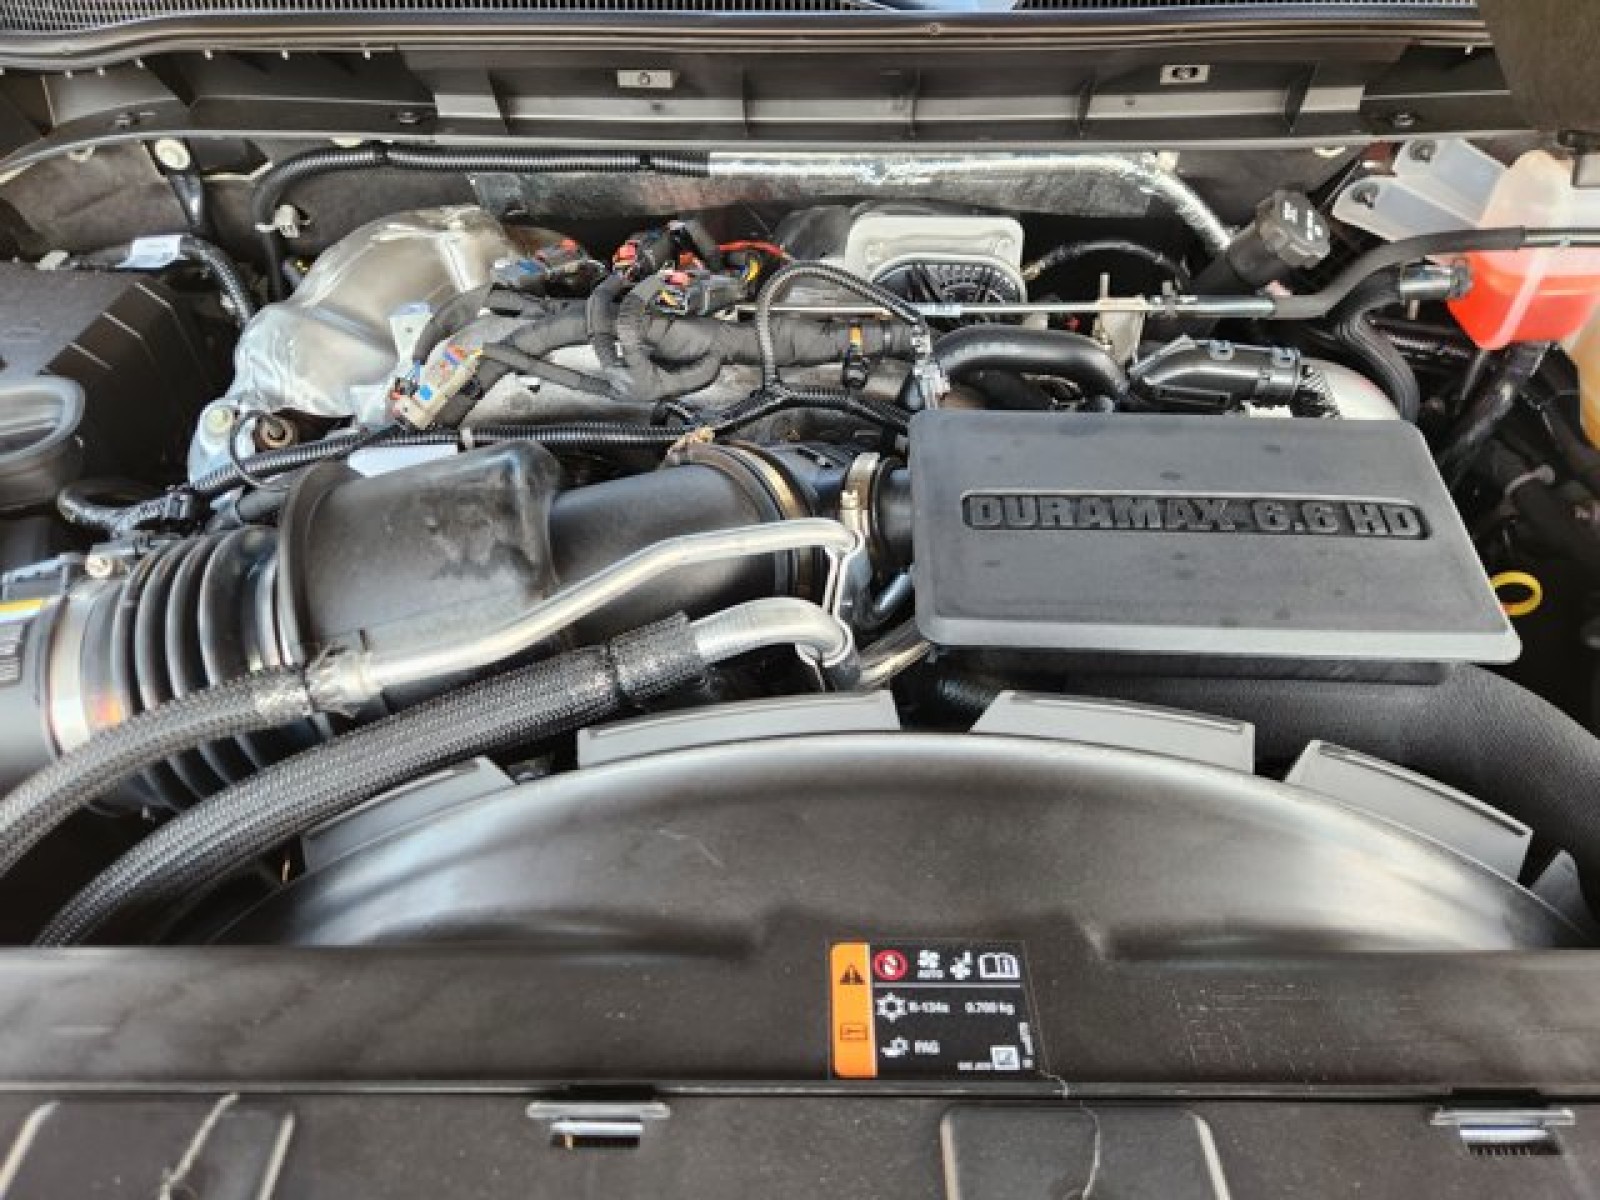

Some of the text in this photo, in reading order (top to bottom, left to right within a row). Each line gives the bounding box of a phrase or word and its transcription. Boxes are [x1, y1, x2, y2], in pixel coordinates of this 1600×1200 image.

[970, 496, 1421, 537] DURAMAX 6.6 HD
